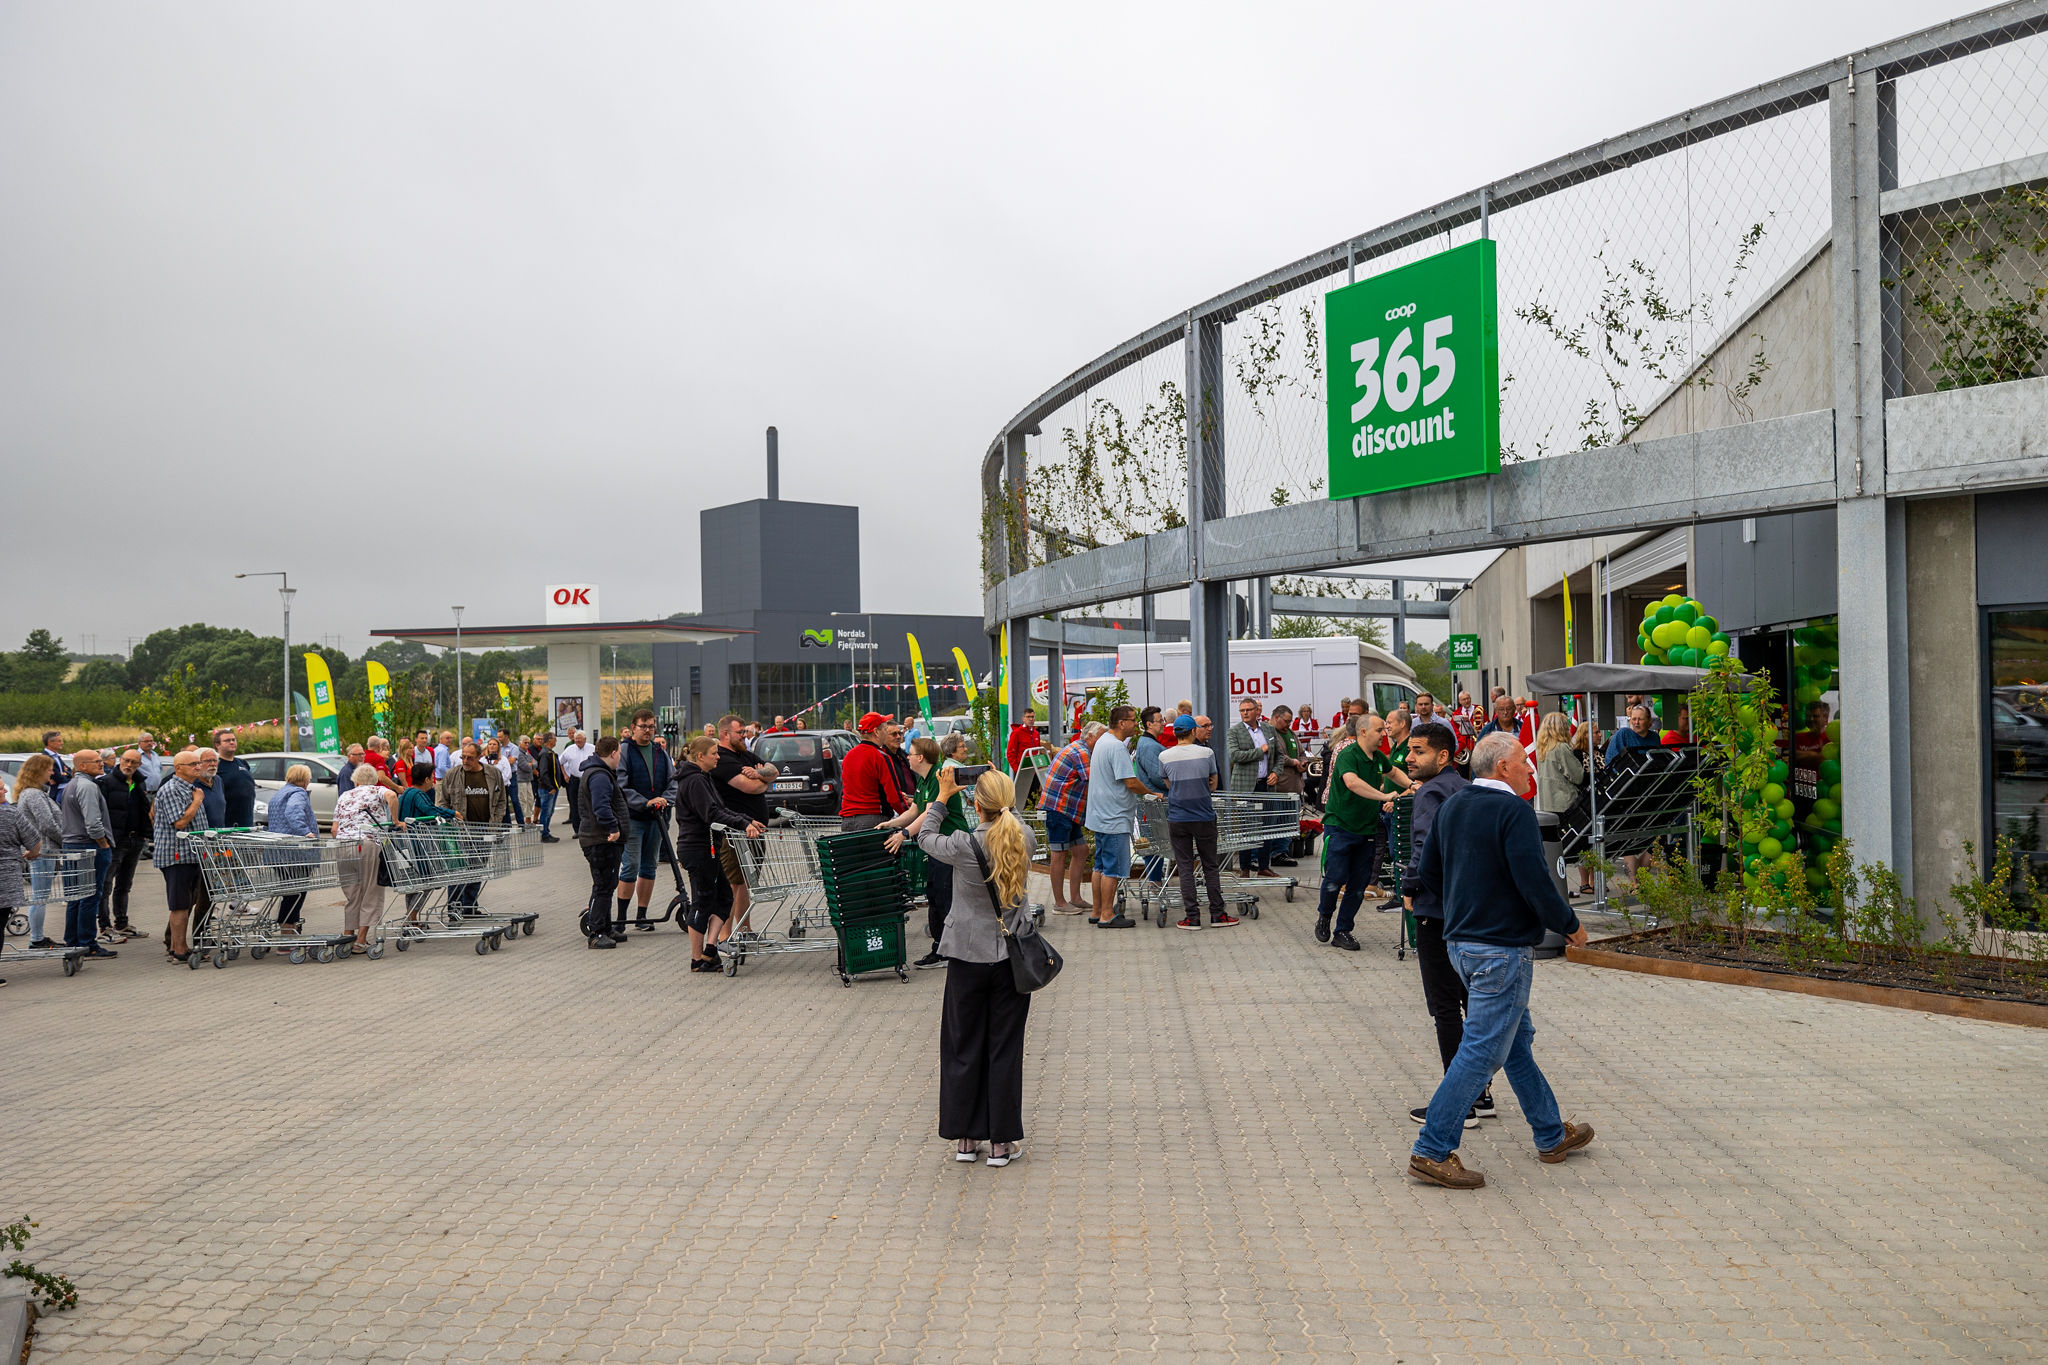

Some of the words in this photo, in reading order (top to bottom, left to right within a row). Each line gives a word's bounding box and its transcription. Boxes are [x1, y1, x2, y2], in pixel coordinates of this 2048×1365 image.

[1385, 303, 1416, 321] coop
[1350, 315, 1456, 424] 365
[1352, 406, 1455, 458] discount
[553, 588, 591, 605] OK
[838, 629, 865, 637] Nordals
[1453, 641, 1474, 653] 365
[1230, 671, 1283, 695] bals
[867, 937, 883, 948] 365
